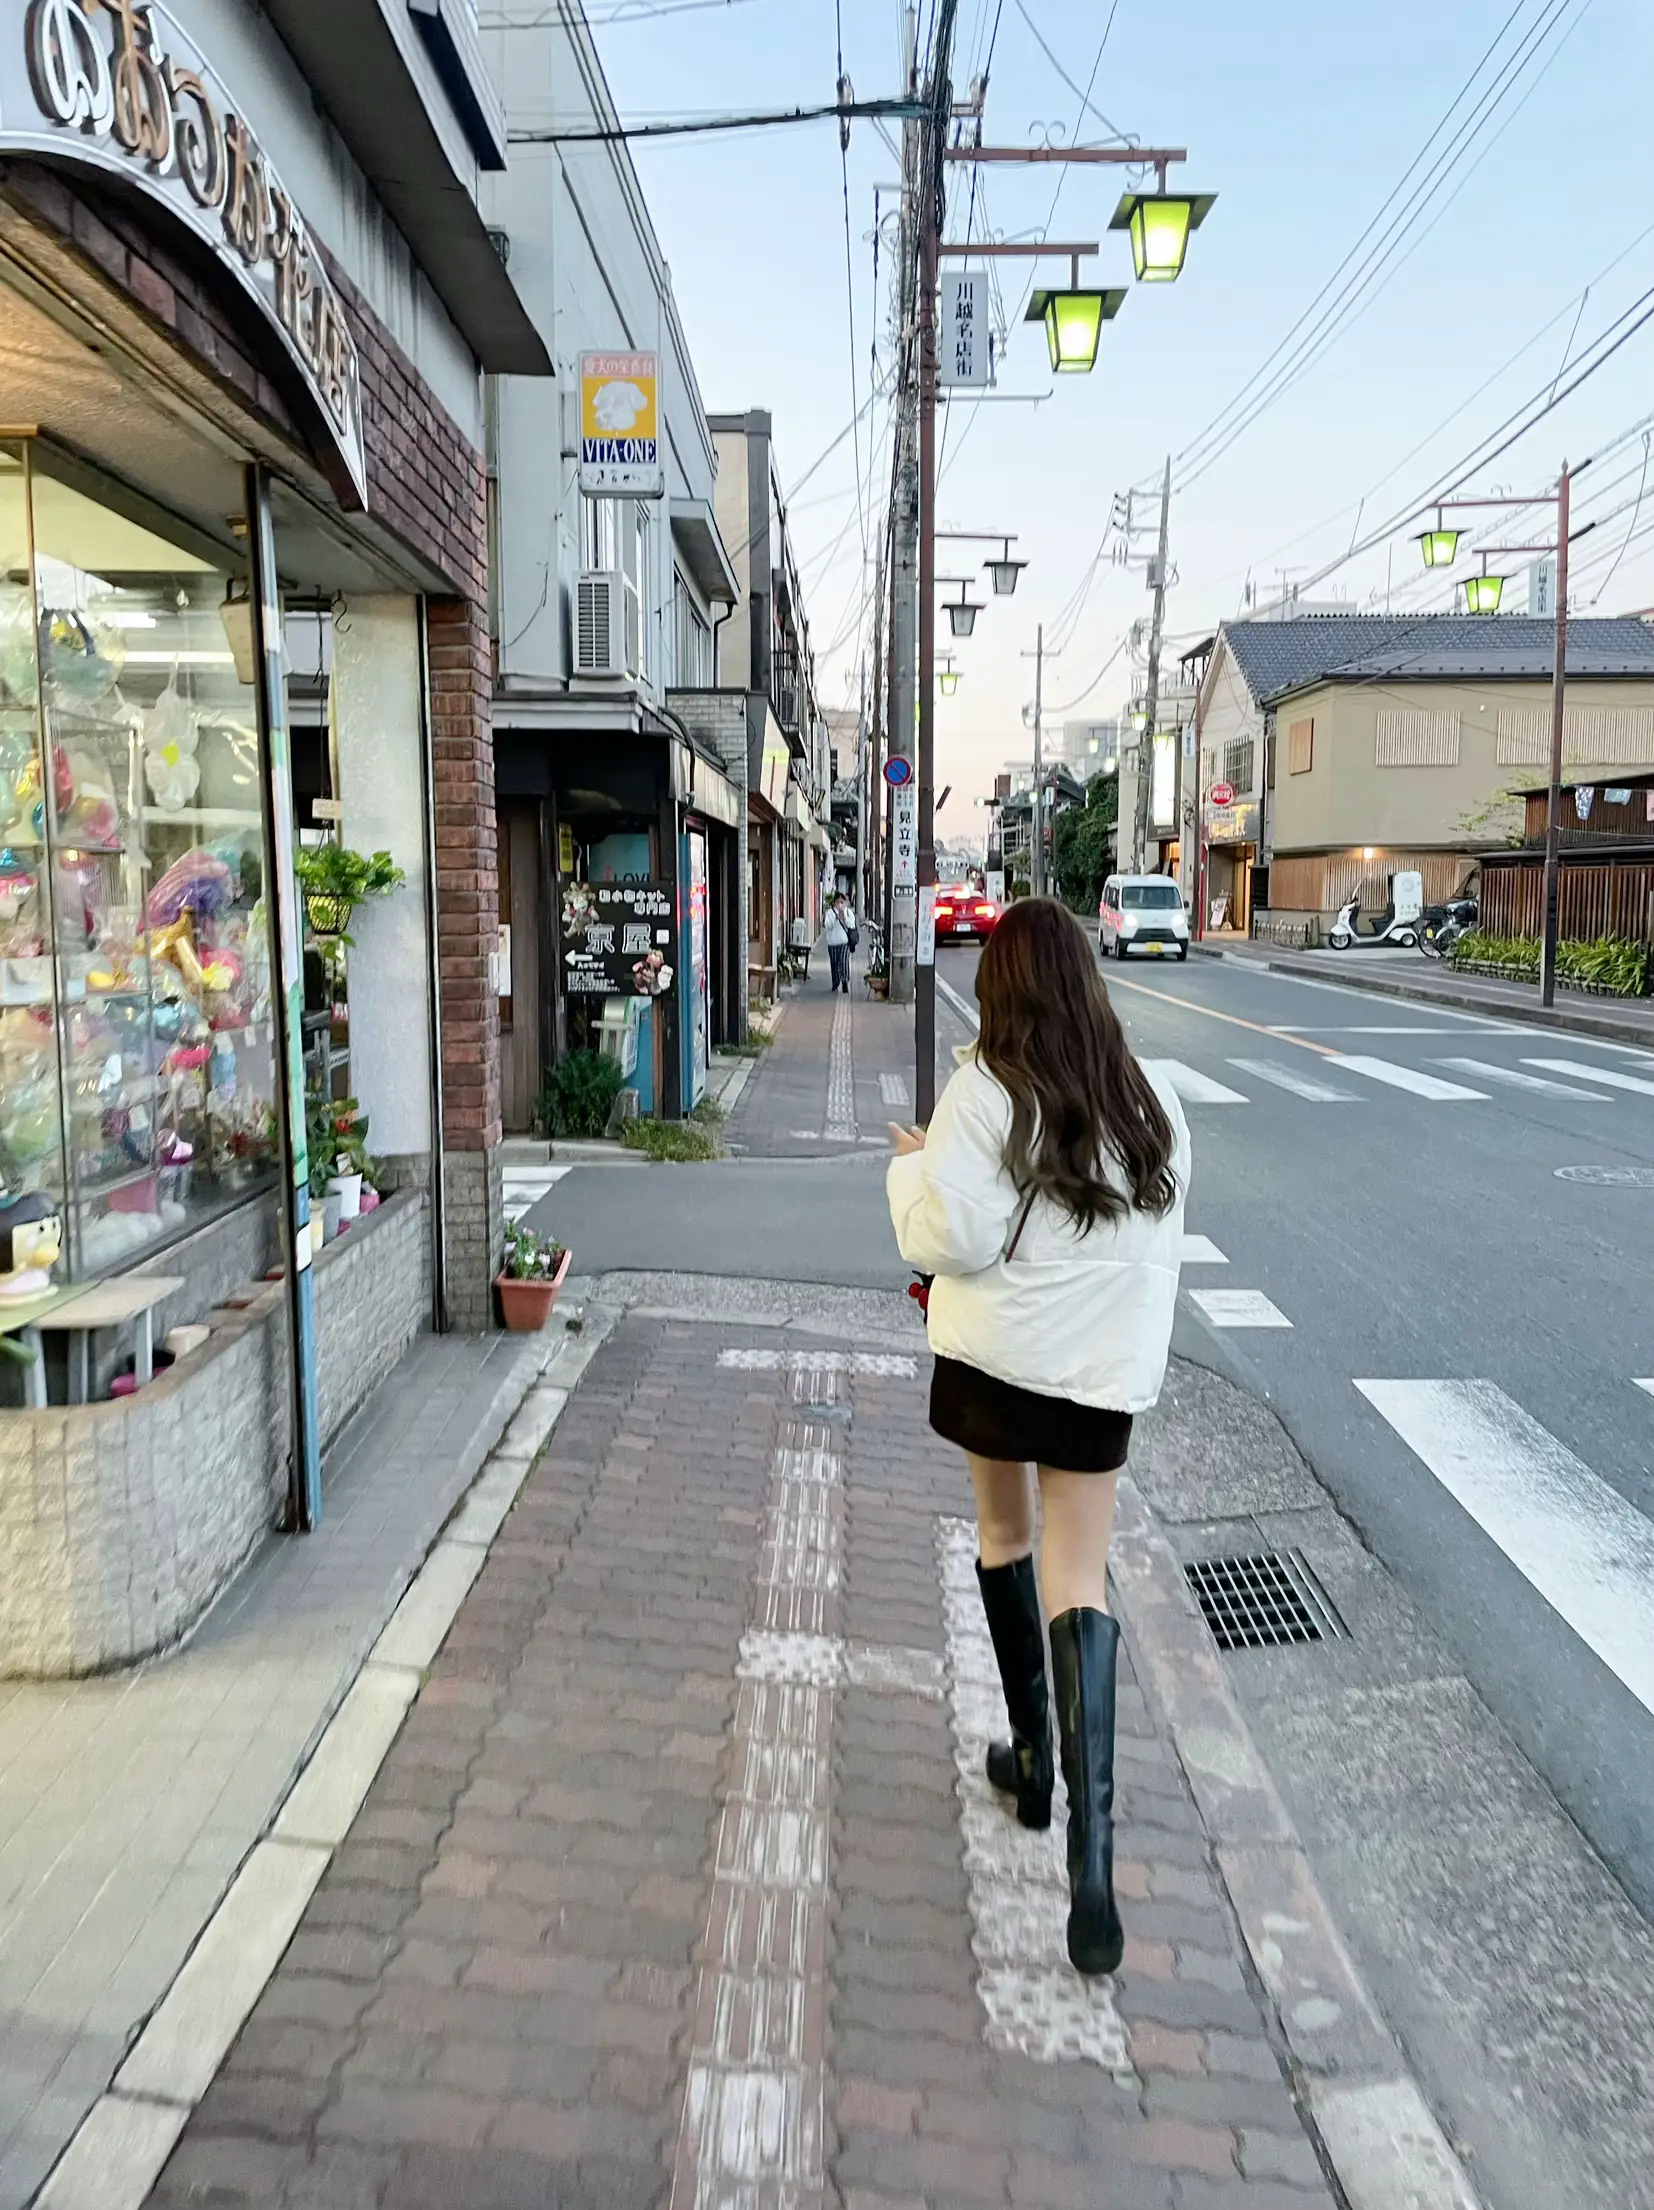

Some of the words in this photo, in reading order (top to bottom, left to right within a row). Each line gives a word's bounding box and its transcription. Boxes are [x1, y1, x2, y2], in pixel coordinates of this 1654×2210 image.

[956, 282, 973, 377] 川越名店街
[584, 439, 656, 463] VITA-ONE
[899, 810, 911, 857] 見立寺
